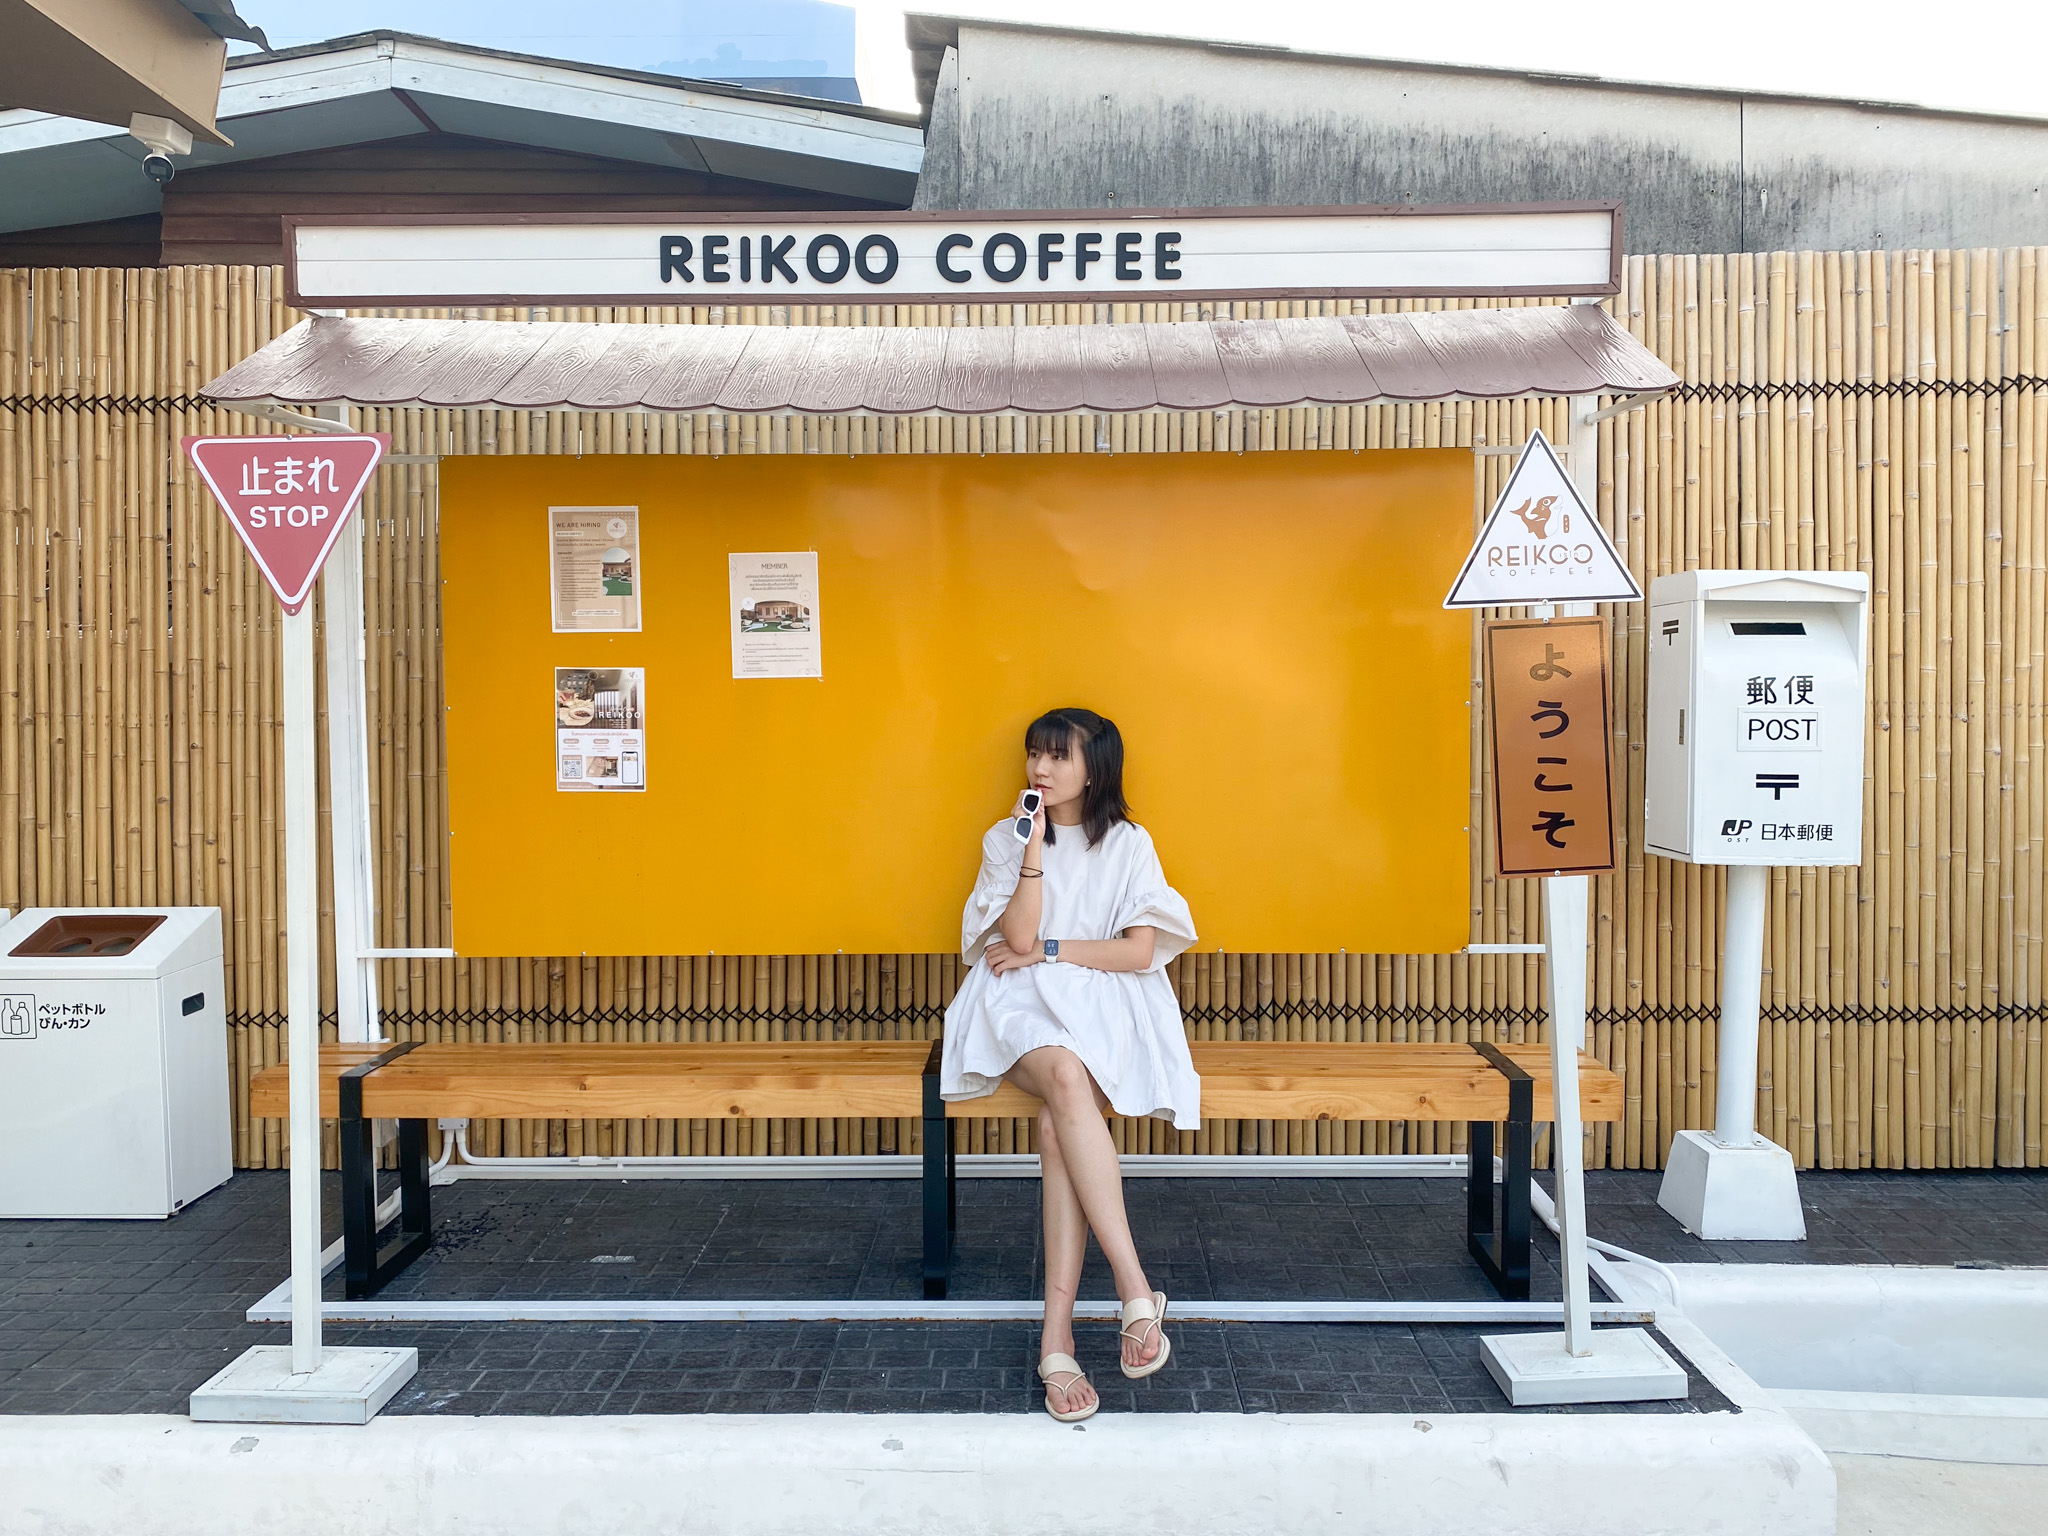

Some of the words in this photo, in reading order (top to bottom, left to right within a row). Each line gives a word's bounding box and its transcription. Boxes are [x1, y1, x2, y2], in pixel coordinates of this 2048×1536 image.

[659, 233, 899, 284] REIKOO
[935, 232, 1182, 283] COFFEE
[238, 455, 339, 495] 止まれ
[249, 505, 329, 528] STOP
[1487, 543, 1593, 567] REIKOO
[1489, 566, 1593, 577] COFFEE
[1746, 675, 1814, 705] 郵便
[598, 711, 641, 719] REIKOO
[1748, 718, 1816, 740] POST
[1529, 643, 1575, 849] ようこそ
[1761, 823, 1833, 841] 日本郵便
[39, 1003, 106, 1015] ペットボトル
